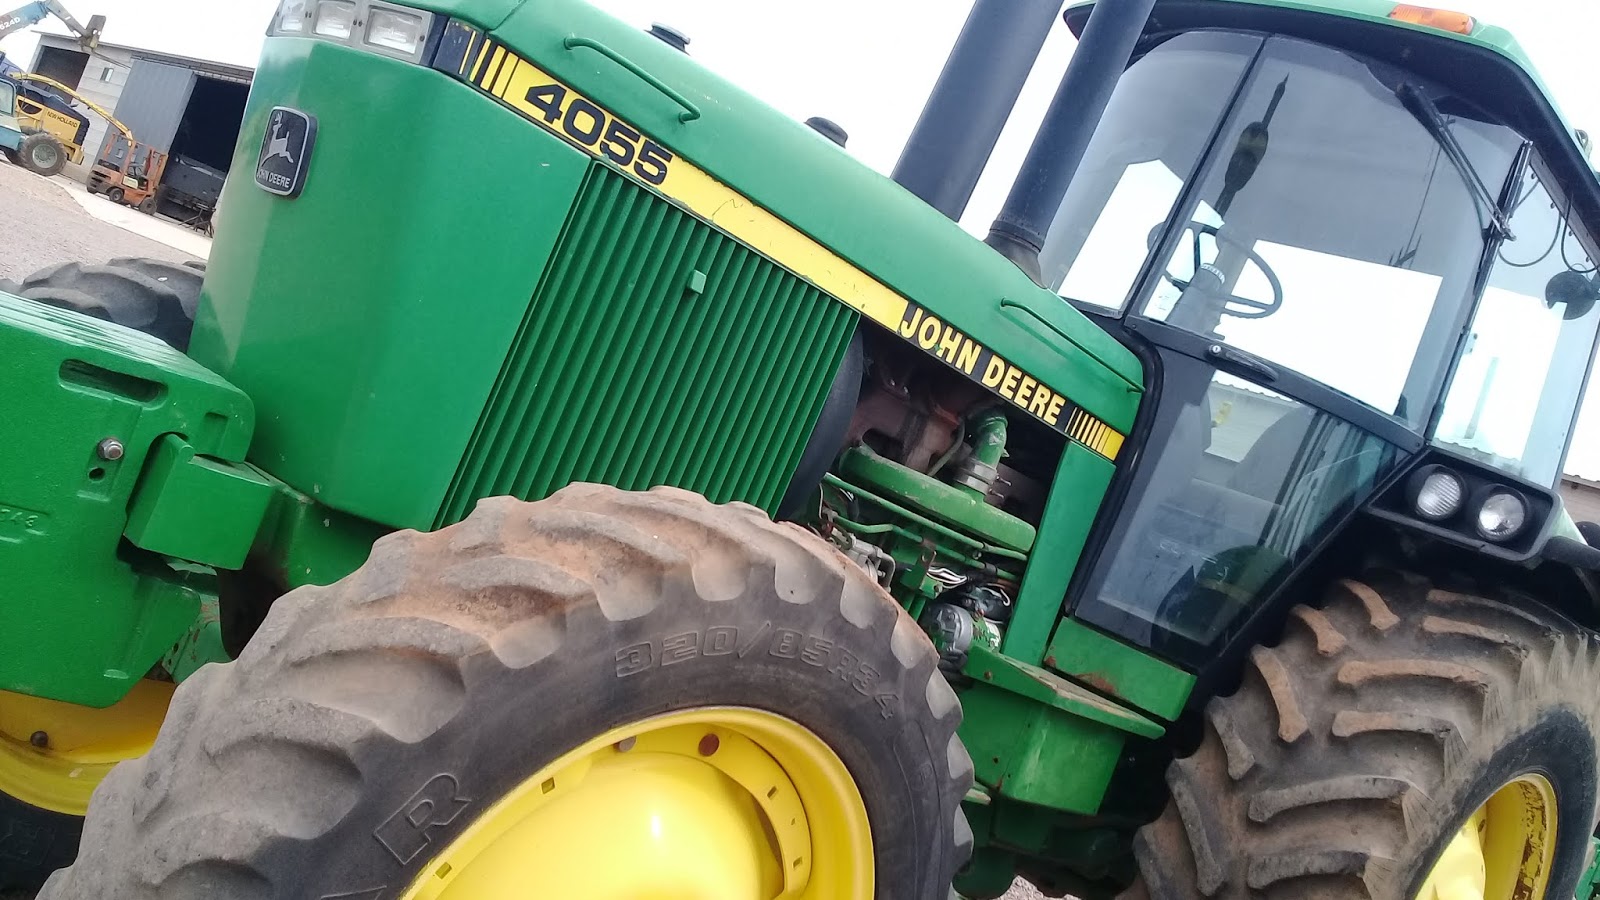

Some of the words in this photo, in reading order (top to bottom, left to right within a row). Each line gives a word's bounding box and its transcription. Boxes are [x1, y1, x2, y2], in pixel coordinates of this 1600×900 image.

[57, 116, 78, 128] HOLLAND
[525, 84, 673, 186] 4055
[269, 172, 291, 188] DEERE
[900, 307, 982, 375] JOHN
[981, 355, 1066, 426] DEERE
